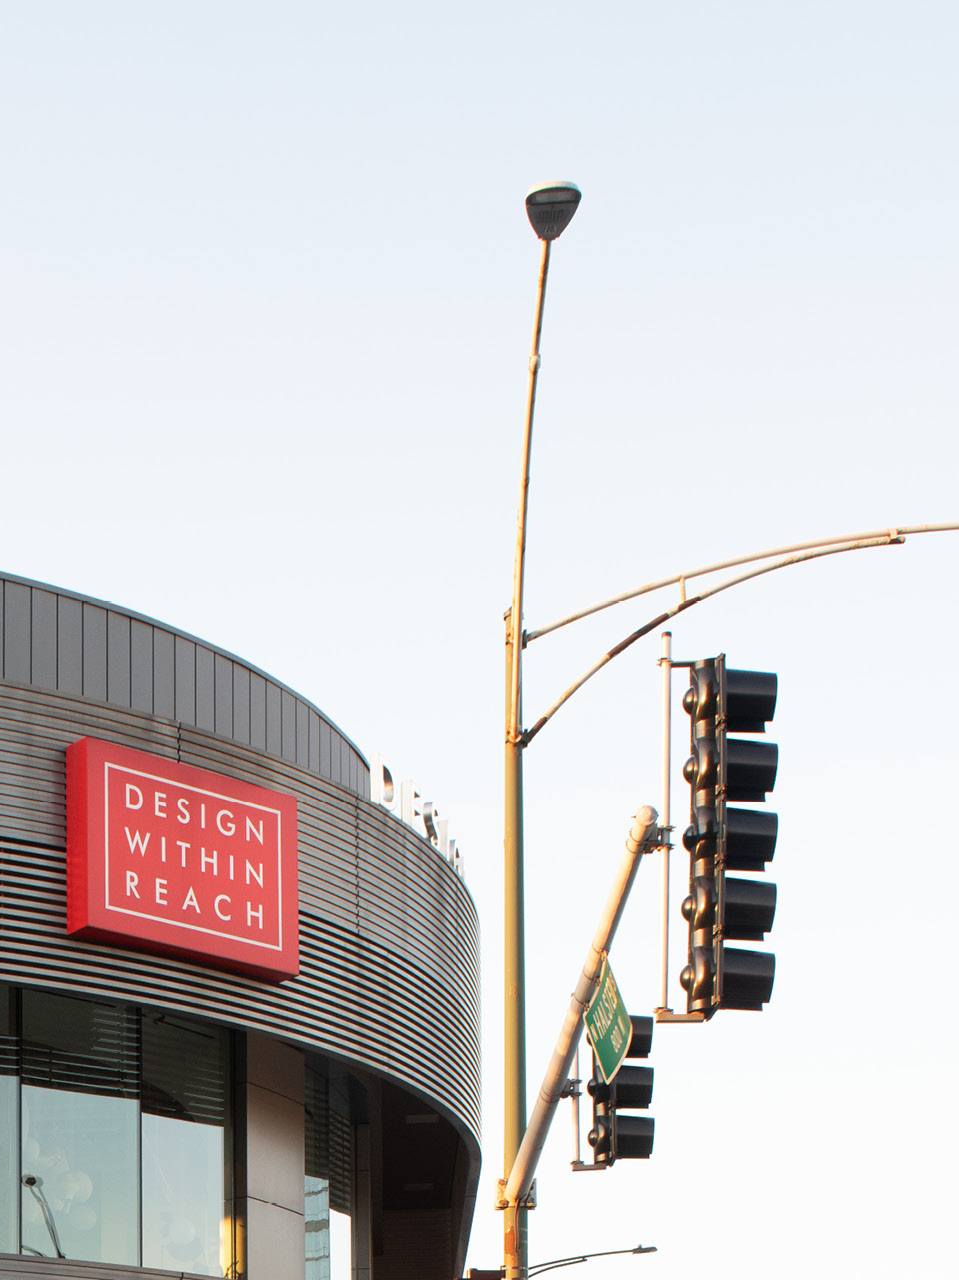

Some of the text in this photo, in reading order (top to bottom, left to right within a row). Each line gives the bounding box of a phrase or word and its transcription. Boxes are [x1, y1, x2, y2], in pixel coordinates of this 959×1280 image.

[125, 783, 264, 846] DESIGN
[124, 826, 264, 889] WITHIN
[126, 870, 263, 929] REACH
[593, 976, 618, 1040] HALSTED
